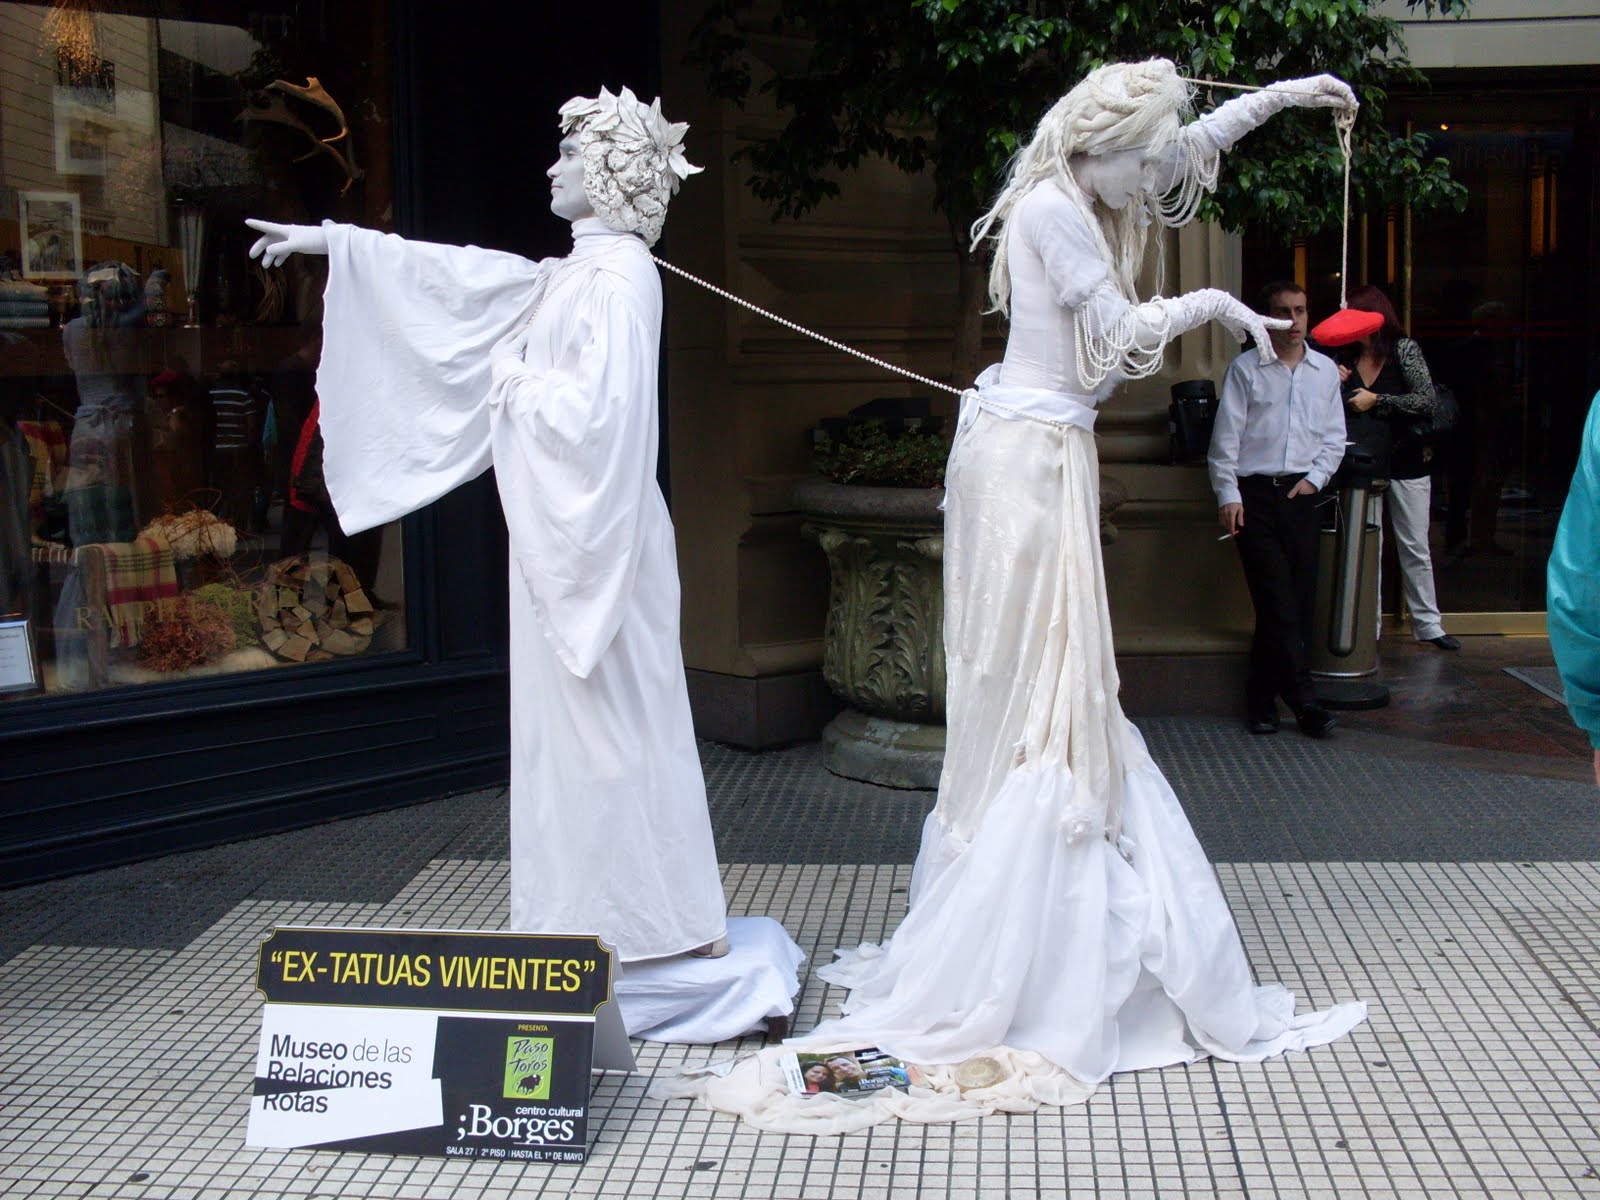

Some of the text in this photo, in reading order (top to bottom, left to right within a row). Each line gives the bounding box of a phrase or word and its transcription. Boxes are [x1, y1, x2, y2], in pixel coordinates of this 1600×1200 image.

[439, 955, 596, 992] VIVIENTES”
[270, 1033, 412, 1064] Museo de las
[513, 1038, 549, 1058] Paso
[267, 1060, 392, 1089] Relaciones
[509, 1057, 548, 1075] Toros
[263, 1091, 329, 1114] Rotas
[515, 1106, 584, 1117] centro cultural
[446, 1146, 464, 1155] SALA
[465, 1147, 475, 1155] 27
[490, 1149, 505, 1157] PISO
[511, 1149, 533, 1159] HASTA
[534, 1150, 543, 1159] EL
[553, 1152, 562, 1160] DE
[563, 1152, 583, 1161] MAYO
